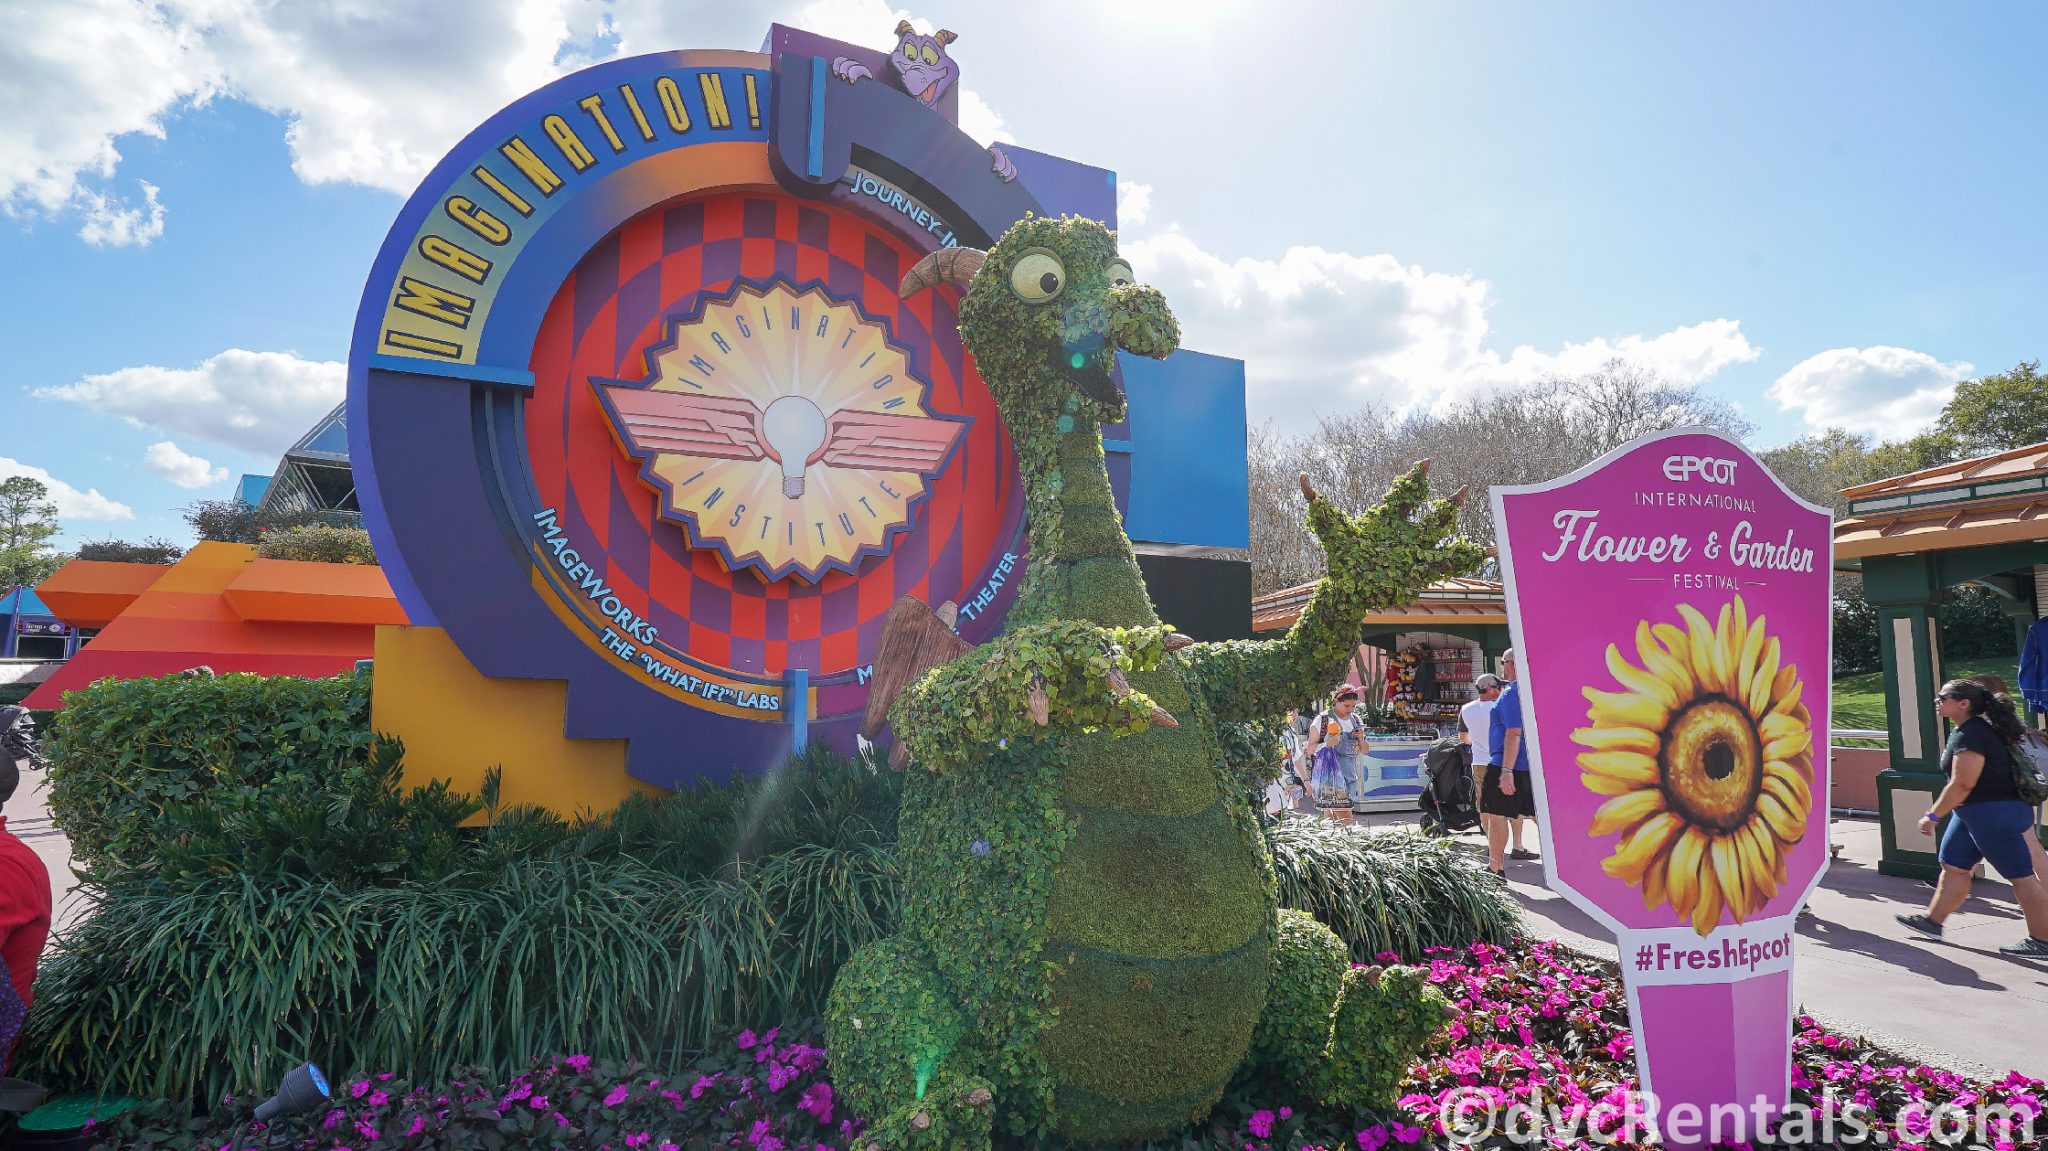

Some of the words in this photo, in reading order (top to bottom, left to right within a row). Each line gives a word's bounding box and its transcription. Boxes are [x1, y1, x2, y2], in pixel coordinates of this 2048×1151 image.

[385, 73, 763, 360] IMAGINATION!
[850, 171, 942, 232] JOURNEY
[678, 305, 906, 410] IMAGINATION
[1634, 492, 1756, 513] INTERNATIONAL
[1662, 455, 1738, 486] EPCOT
[682, 471, 901, 546] INSTITUTE
[1542, 509, 1692, 563] Flower
[1704, 531, 1722, 560] &
[1729, 520, 1814, 573] Garden
[533, 507, 659, 646] IMAGEWORKS
[960, 551, 1019, 621] THEATER
[1673, 573, 1739, 591] FESTIVAL
[600, 627, 637, 661] THE
[736, 691, 780, 711] LABS
[1635, 932, 1790, 973] #FreshEpcot
